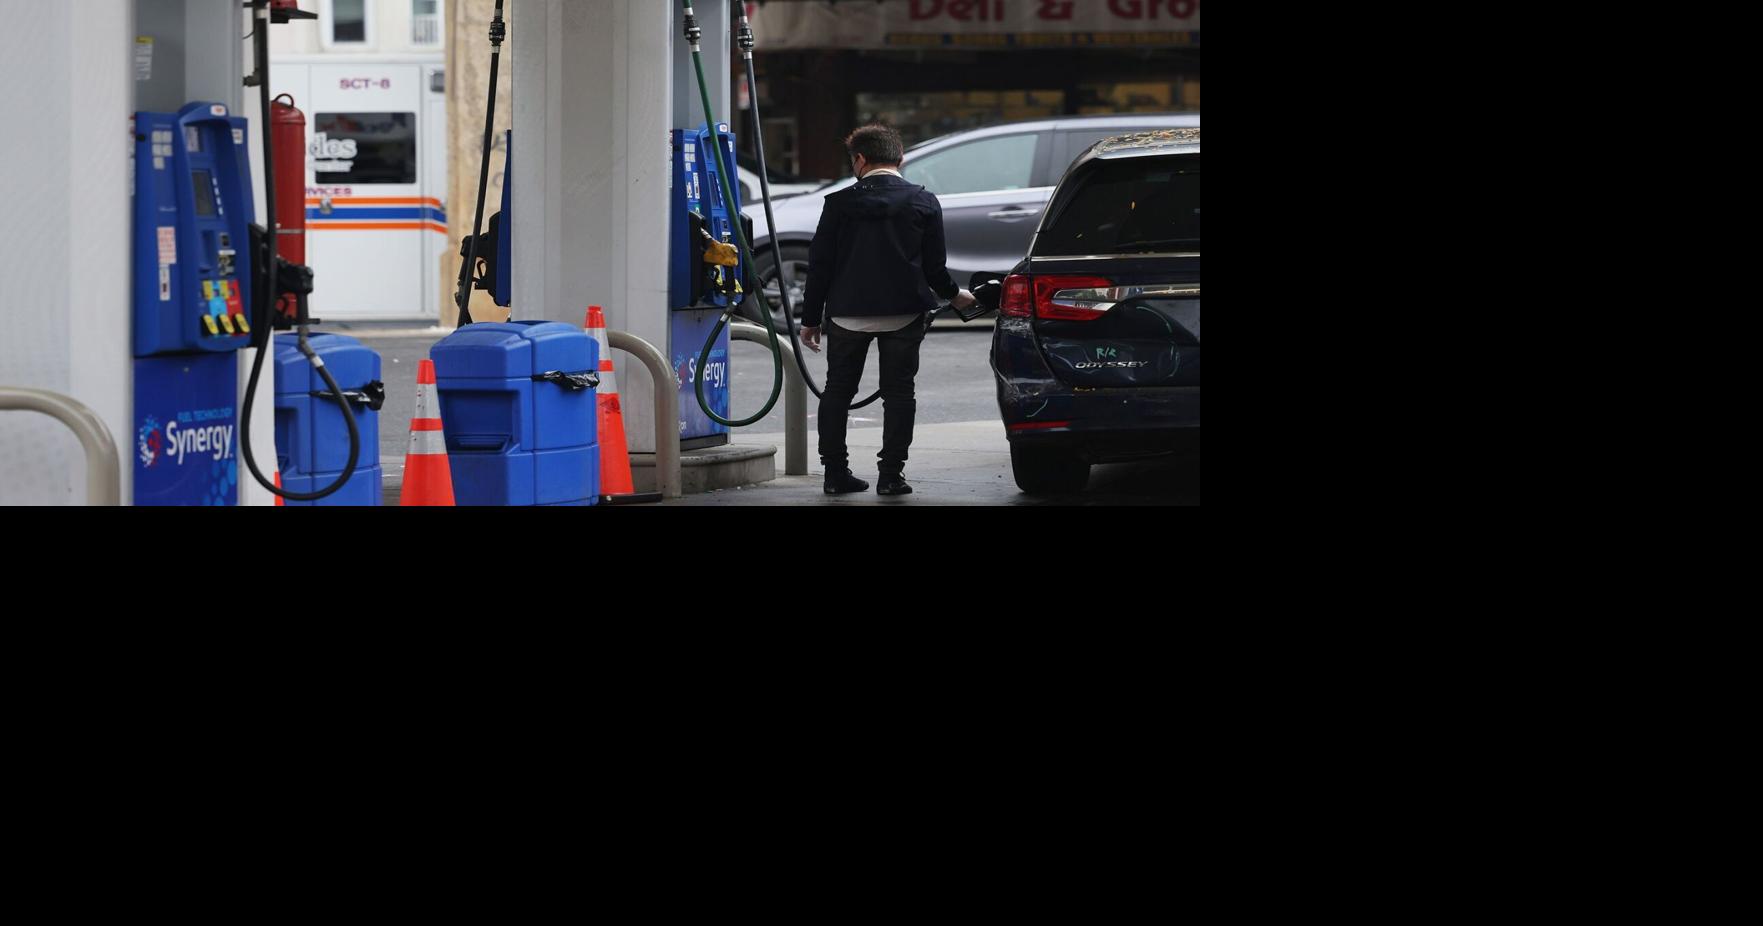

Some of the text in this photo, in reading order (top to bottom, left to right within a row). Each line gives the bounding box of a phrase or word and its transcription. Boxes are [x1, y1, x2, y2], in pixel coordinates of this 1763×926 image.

[909, 0, 1004, 21] Deli
[1108, 0, 1200, 20] Gro
[688, 358, 725, 388] Sergy
[1075, 361, 1149, 369] ODYSSEY
[166, 420, 233, 465] Synergy
